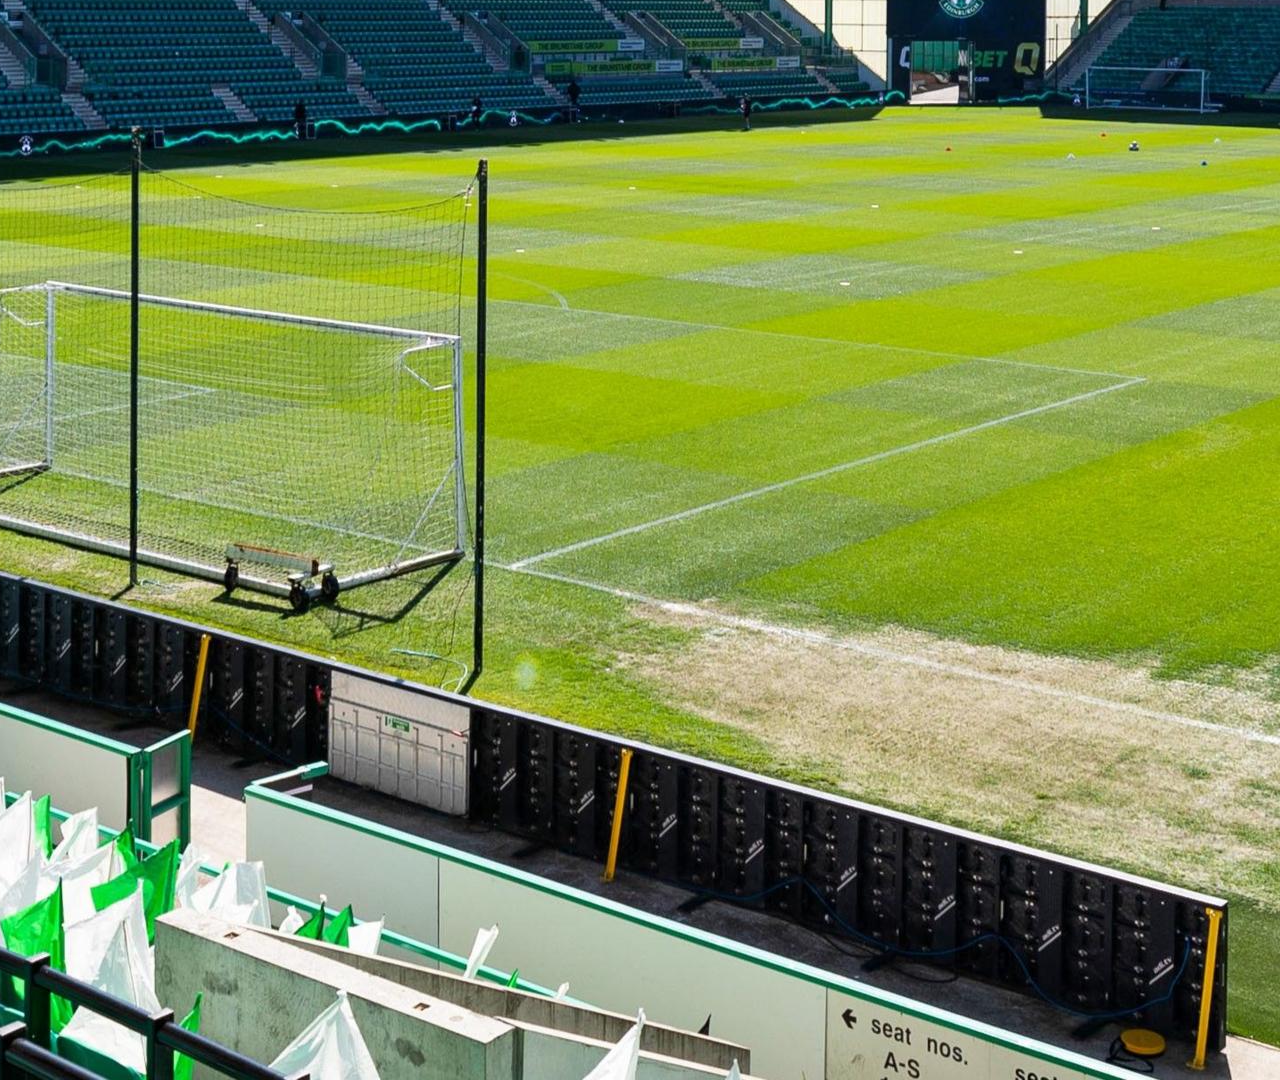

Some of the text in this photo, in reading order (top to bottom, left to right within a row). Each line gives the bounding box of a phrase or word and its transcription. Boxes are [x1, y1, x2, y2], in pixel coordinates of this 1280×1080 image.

[943, 2, 980, 15] EDINBURGH
[1014, 42, 1040, 75] Q
[871, 1018, 969, 1065] seat nos.
[884, 1051, 920, 1079] A-S
